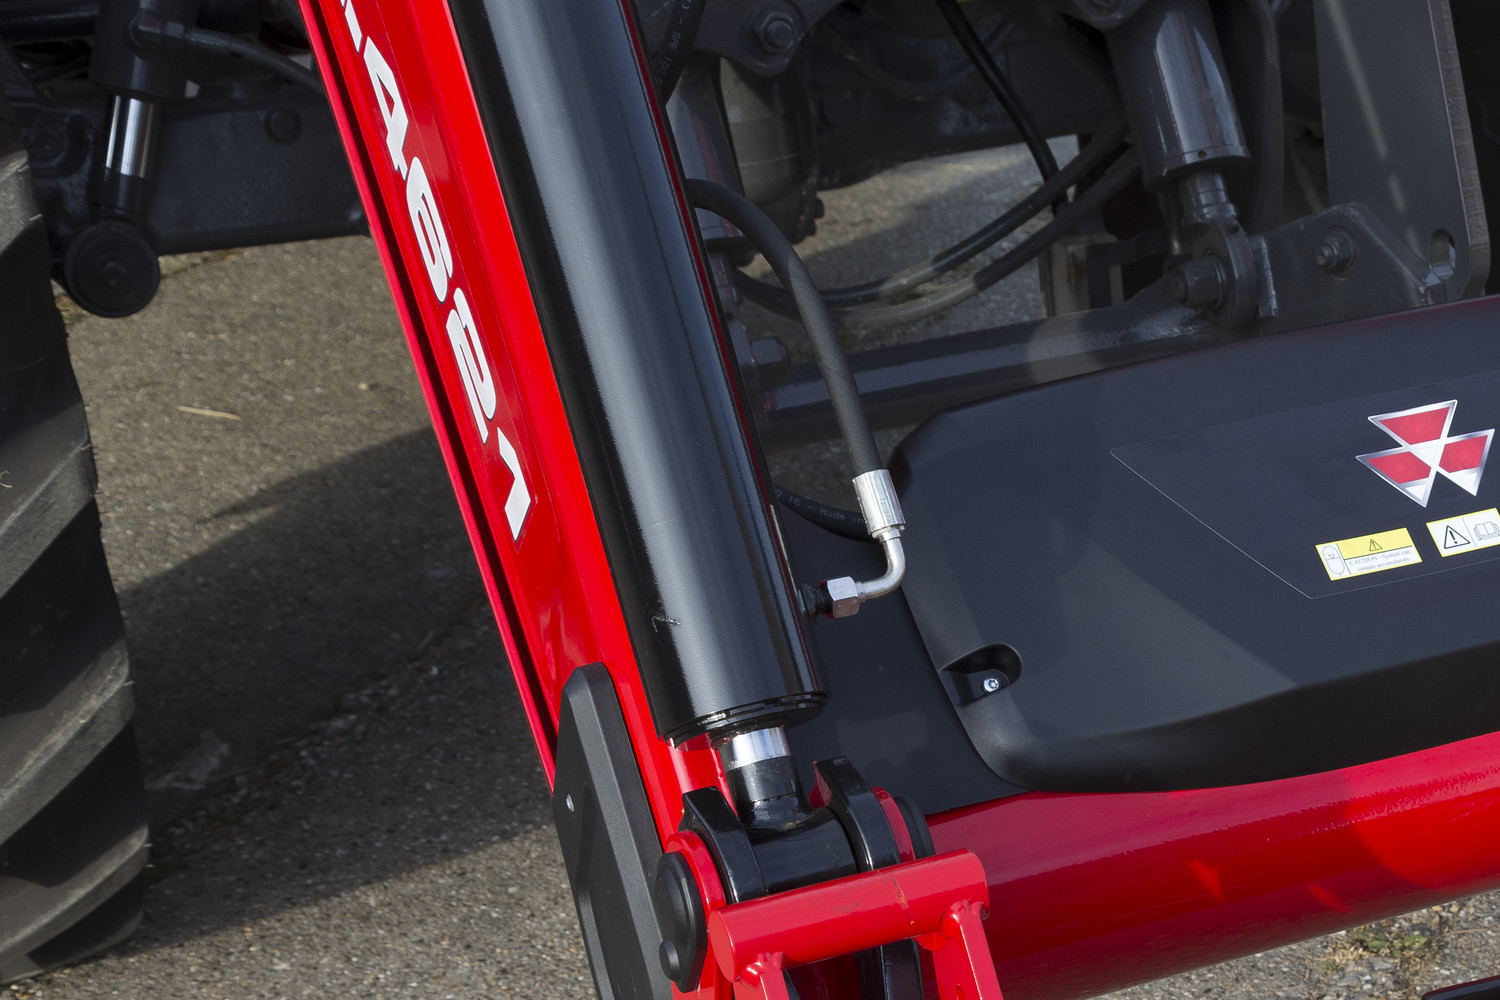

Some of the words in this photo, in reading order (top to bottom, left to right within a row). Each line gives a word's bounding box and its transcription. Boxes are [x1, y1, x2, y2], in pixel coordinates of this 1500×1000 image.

[668, 31, 681, 51] SAE
[340, 0, 531, 541] .4621
[820, 507, 845, 520] Made
[1349, 556, 1378, 566] CAUTION
[1381, 551, 1400, 560] System
[1377, 558, 1410, 567] accumulators
